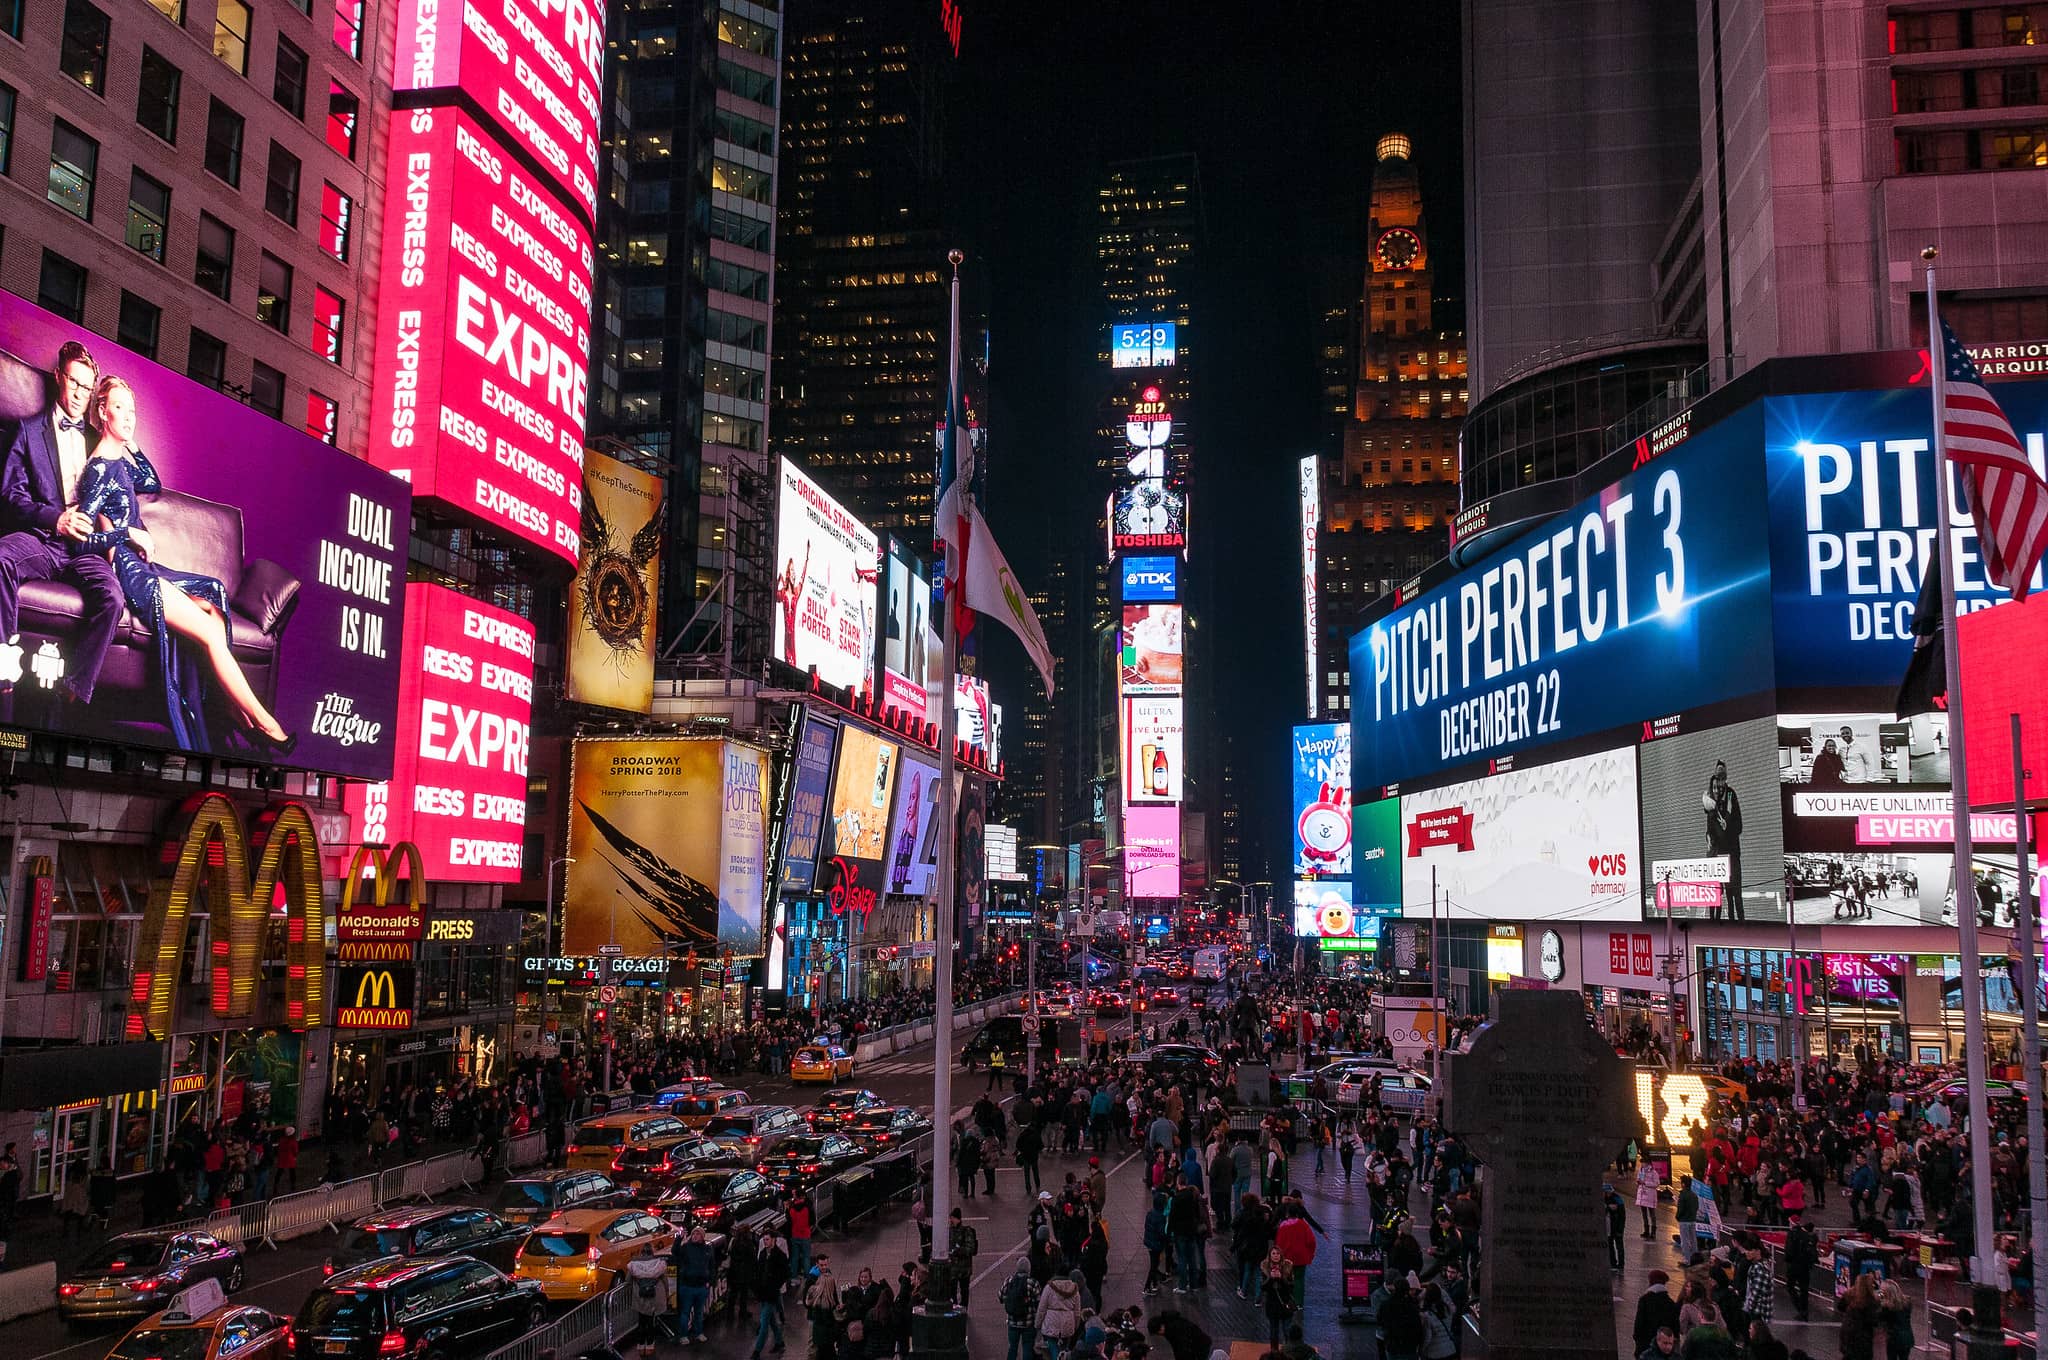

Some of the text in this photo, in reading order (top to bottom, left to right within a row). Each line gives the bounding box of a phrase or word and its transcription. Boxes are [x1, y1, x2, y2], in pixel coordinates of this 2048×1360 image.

[515, 55, 583, 144] EXPRESS
[498, 87, 569, 176] EXPRESS
[401, 152, 431, 287] EXPRESS
[510, 173, 578, 253] EXPRESS
[491, 203, 563, 283] EXPRESS
[505, 265, 573, 338] EXPRESS
[1122, 329, 1167, 347] 5:29
[391, 310, 421, 448] EXPRESS
[1974, 360, 2048, 374] ARQUI
[482, 378, 554, 443] EXPRESS
[1128, 414, 1172, 422] TOSHIBA
[1135, 403, 1165, 414] 2017
[1652, 410, 1692, 442] MARRIOTT
[1652, 427, 1688, 456] MARQUIS
[495, 438, 565, 498] EXPRESS
[475, 478, 549, 537] EXPRESS
[786, 474, 797, 491] THE
[798, 478, 832, 520] ORIGINAL
[833, 509, 855, 538] STARS
[1457, 501, 1491, 526] MARRIOTT
[347, 492, 394, 552] DUAL
[1457, 516, 1488, 539] MARQUIS
[1115, 534, 1184, 547] TOSHIBA
[318, 539, 393, 605] INCOME
[1136, 572, 1172, 584] TDK
[807, 596, 828, 622] BILLY
[1374, 469, 1685, 722] PITCH PERFECT 3
[340, 605, 386, 659] IS IN.
[464, 609, 532, 659] EXPRESS
[801, 612, 831, 643] PORTER
[839, 618, 861, 643] STARK
[838, 635, 861, 659] SANDS
[325, 691, 354, 716] THE
[1441, 668, 1562, 761] DECEMBER 22
[311, 700, 381, 747] league
[1654, 715, 1681, 728] MARRIOTT
[1654, 724, 1679, 737] MARQUIS
[905, 711, 988, 770] BRODWAY
[1296, 736, 1338, 764] Happy
[610, 767, 682, 776] SPRING 2018
[612, 756, 681, 766] BROADWAY
[728, 753, 764, 791] HARRY
[601, 789, 689, 797] HarryPotterThePlay.com
[725, 781, 764, 816] POTTER
[1805, 797, 1955, 812] YOU HAVE UNLIMITE
[450, 837, 521, 868] EXPRESS
[1600, 853, 1626, 877] CVS
[1591, 879, 1626, 897] pharmacy
[1672, 883, 1717, 903] WIRELESS
[340, 915, 420, 928] McDonald's
[352, 928, 405, 937] Restaurant
[1634, 939, 1649, 953] UNI
[588, 958, 669, 973] LGGAGE
[1634, 957, 1650, 971] QLO
